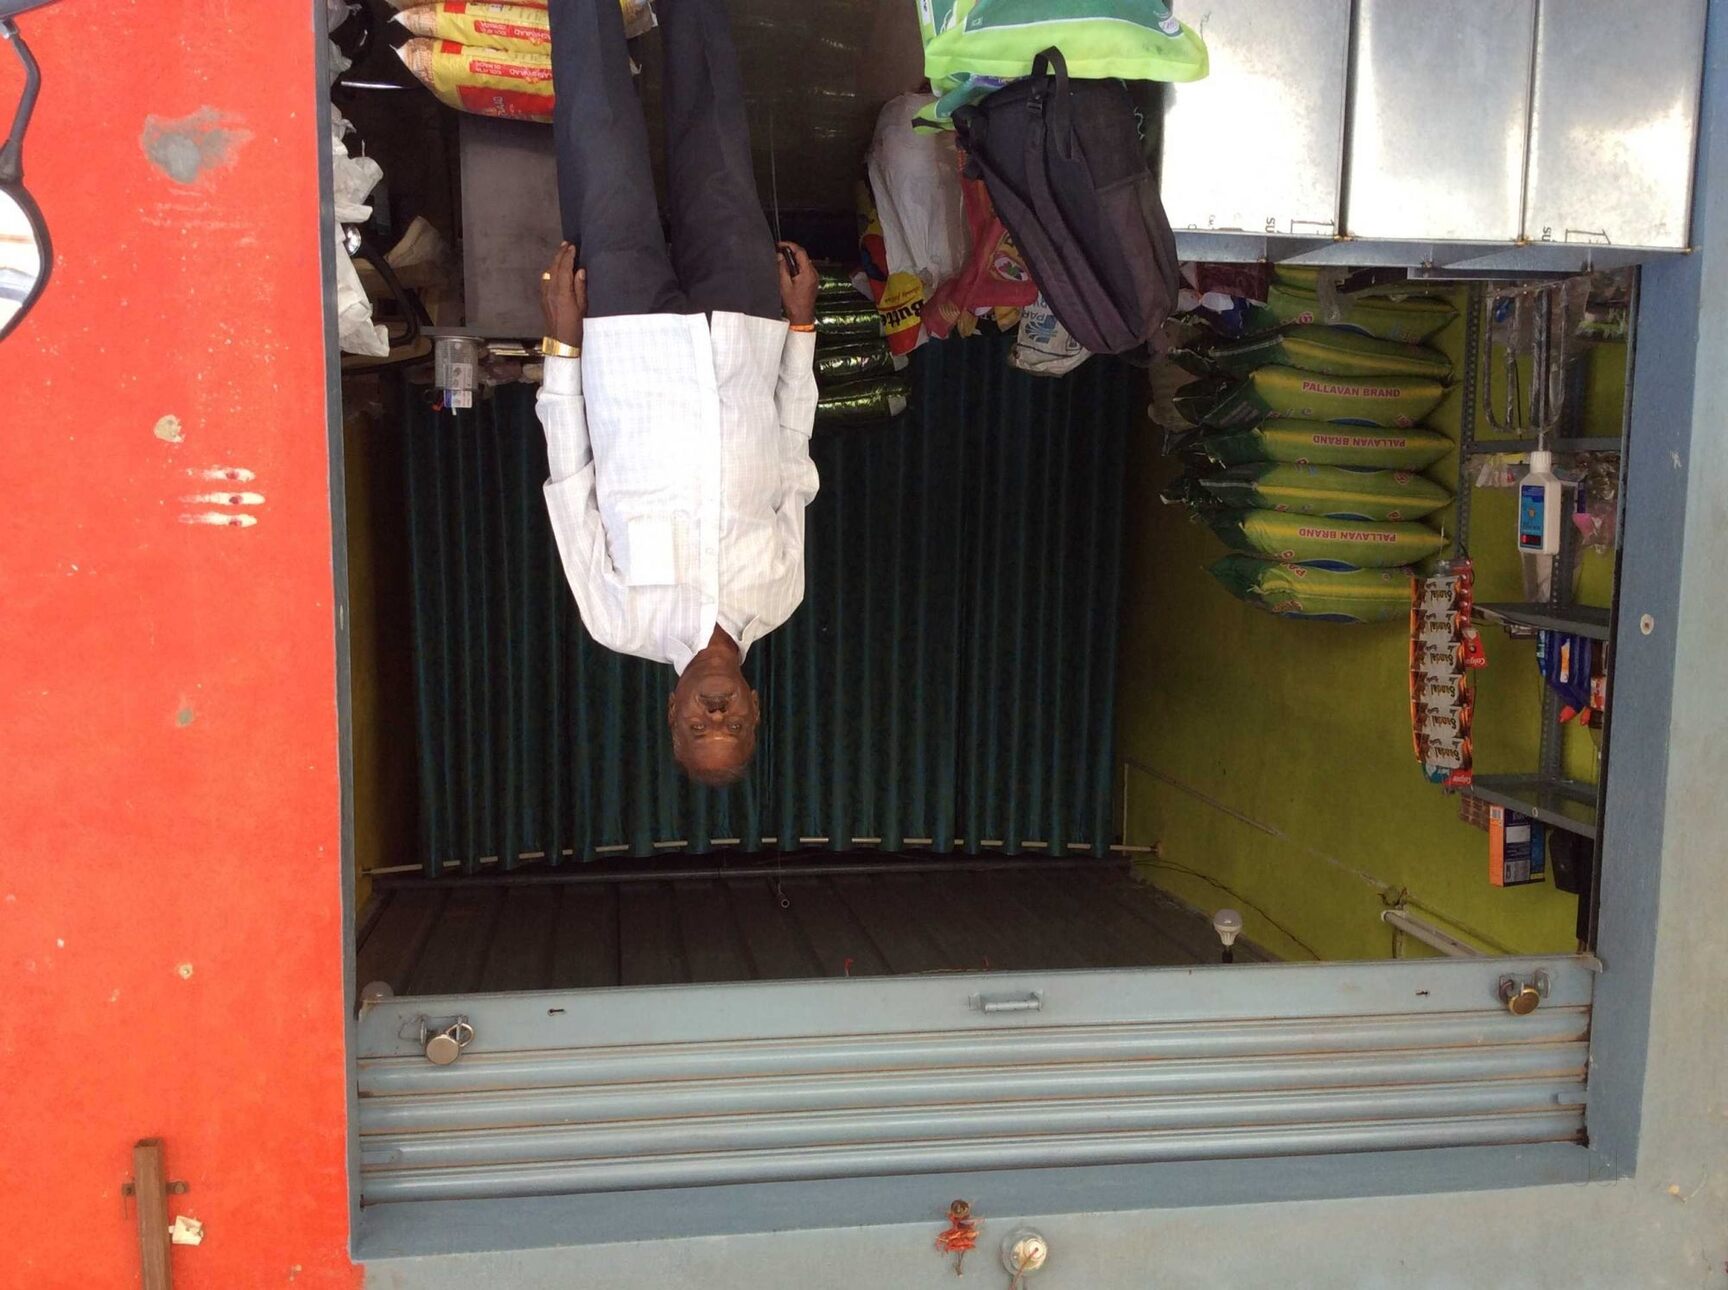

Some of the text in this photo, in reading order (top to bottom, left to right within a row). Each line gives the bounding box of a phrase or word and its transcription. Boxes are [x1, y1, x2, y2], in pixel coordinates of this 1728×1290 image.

[1301, 381, 1401, 399] PALLAVAN BRAND
[1311, 435, 1407, 448] PALLAVAN BRAND
[1298, 528, 1397, 542] PALLAVAN BRAND
